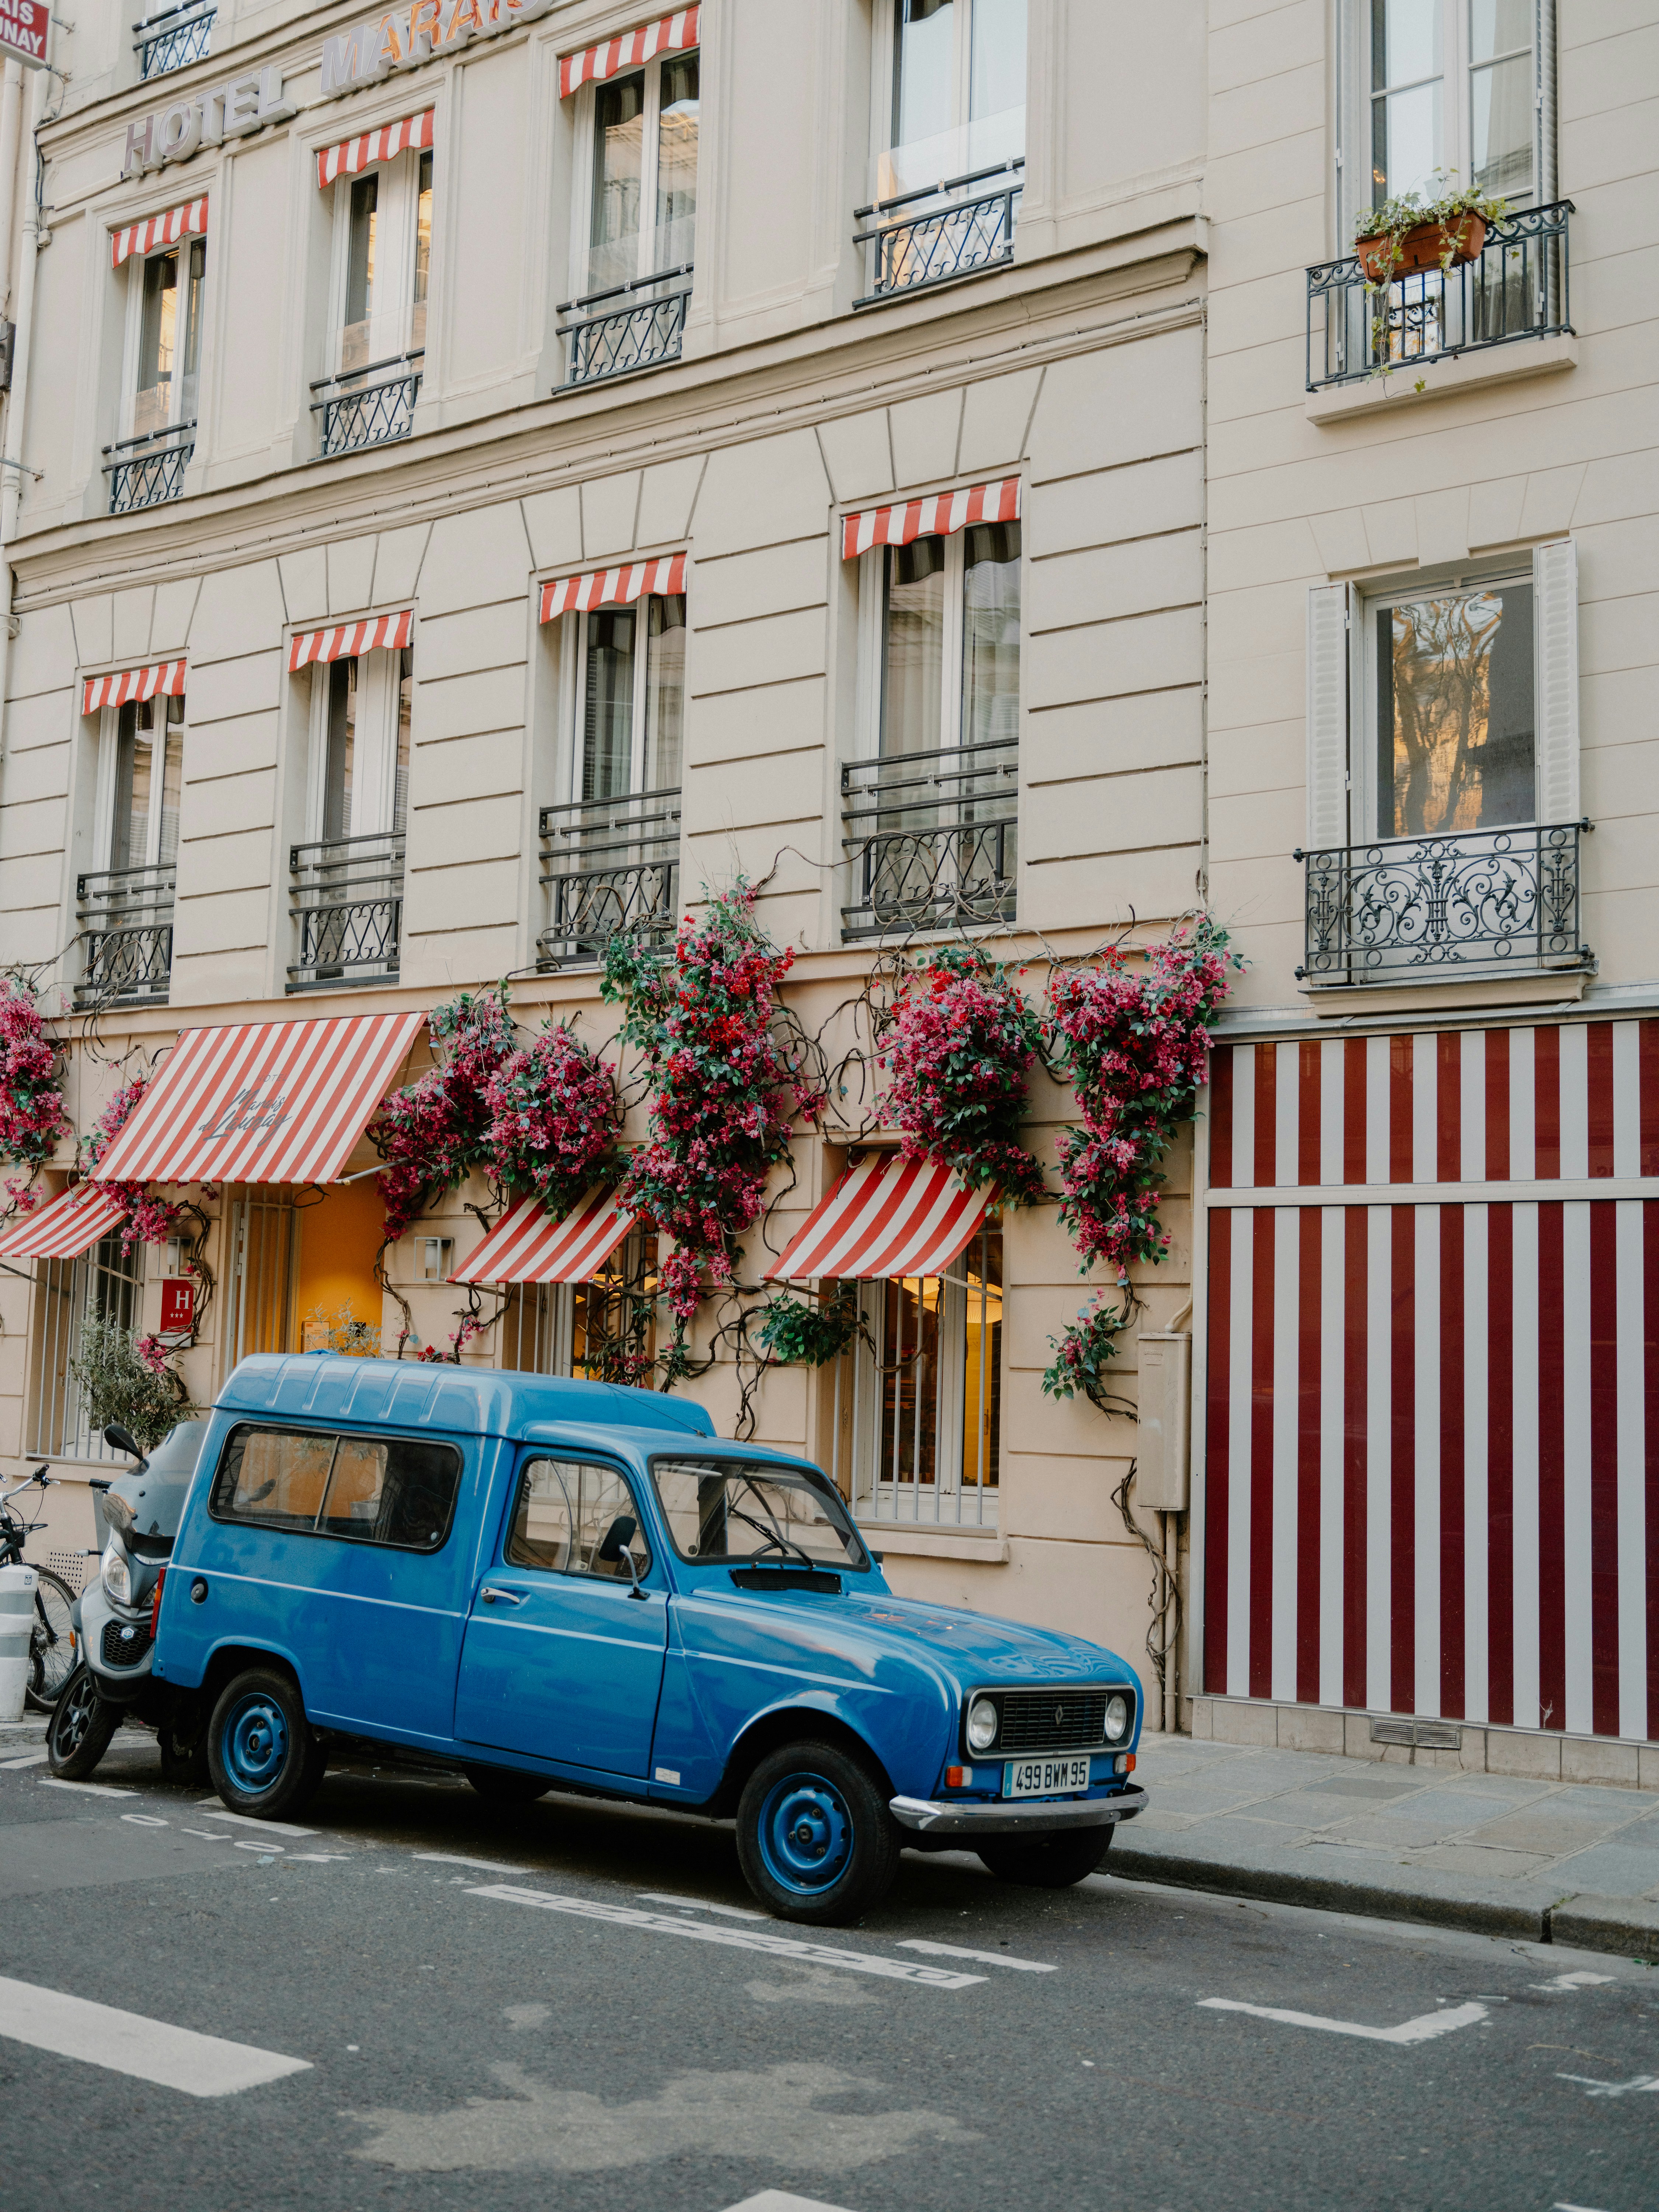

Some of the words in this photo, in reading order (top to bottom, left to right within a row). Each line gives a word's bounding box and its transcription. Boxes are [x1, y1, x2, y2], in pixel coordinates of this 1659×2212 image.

[124, 65, 293, 175] HOTEL
[320, 0, 541, 94] MARAI
[257, 1074, 287, 1082] HOTEL
[223, 1089, 285, 1114] Marais
[198, 1113, 217, 1132] de
[203, 1110, 292, 1147] Launay
[175, 1290, 191, 1309] H
[1016, 1765, 1041, 1790] 499
[1044, 1762, 1068, 1788] BWM
[1071, 1761, 1086, 1785] 95
[497, 1890, 959, 1981] PAYANT
